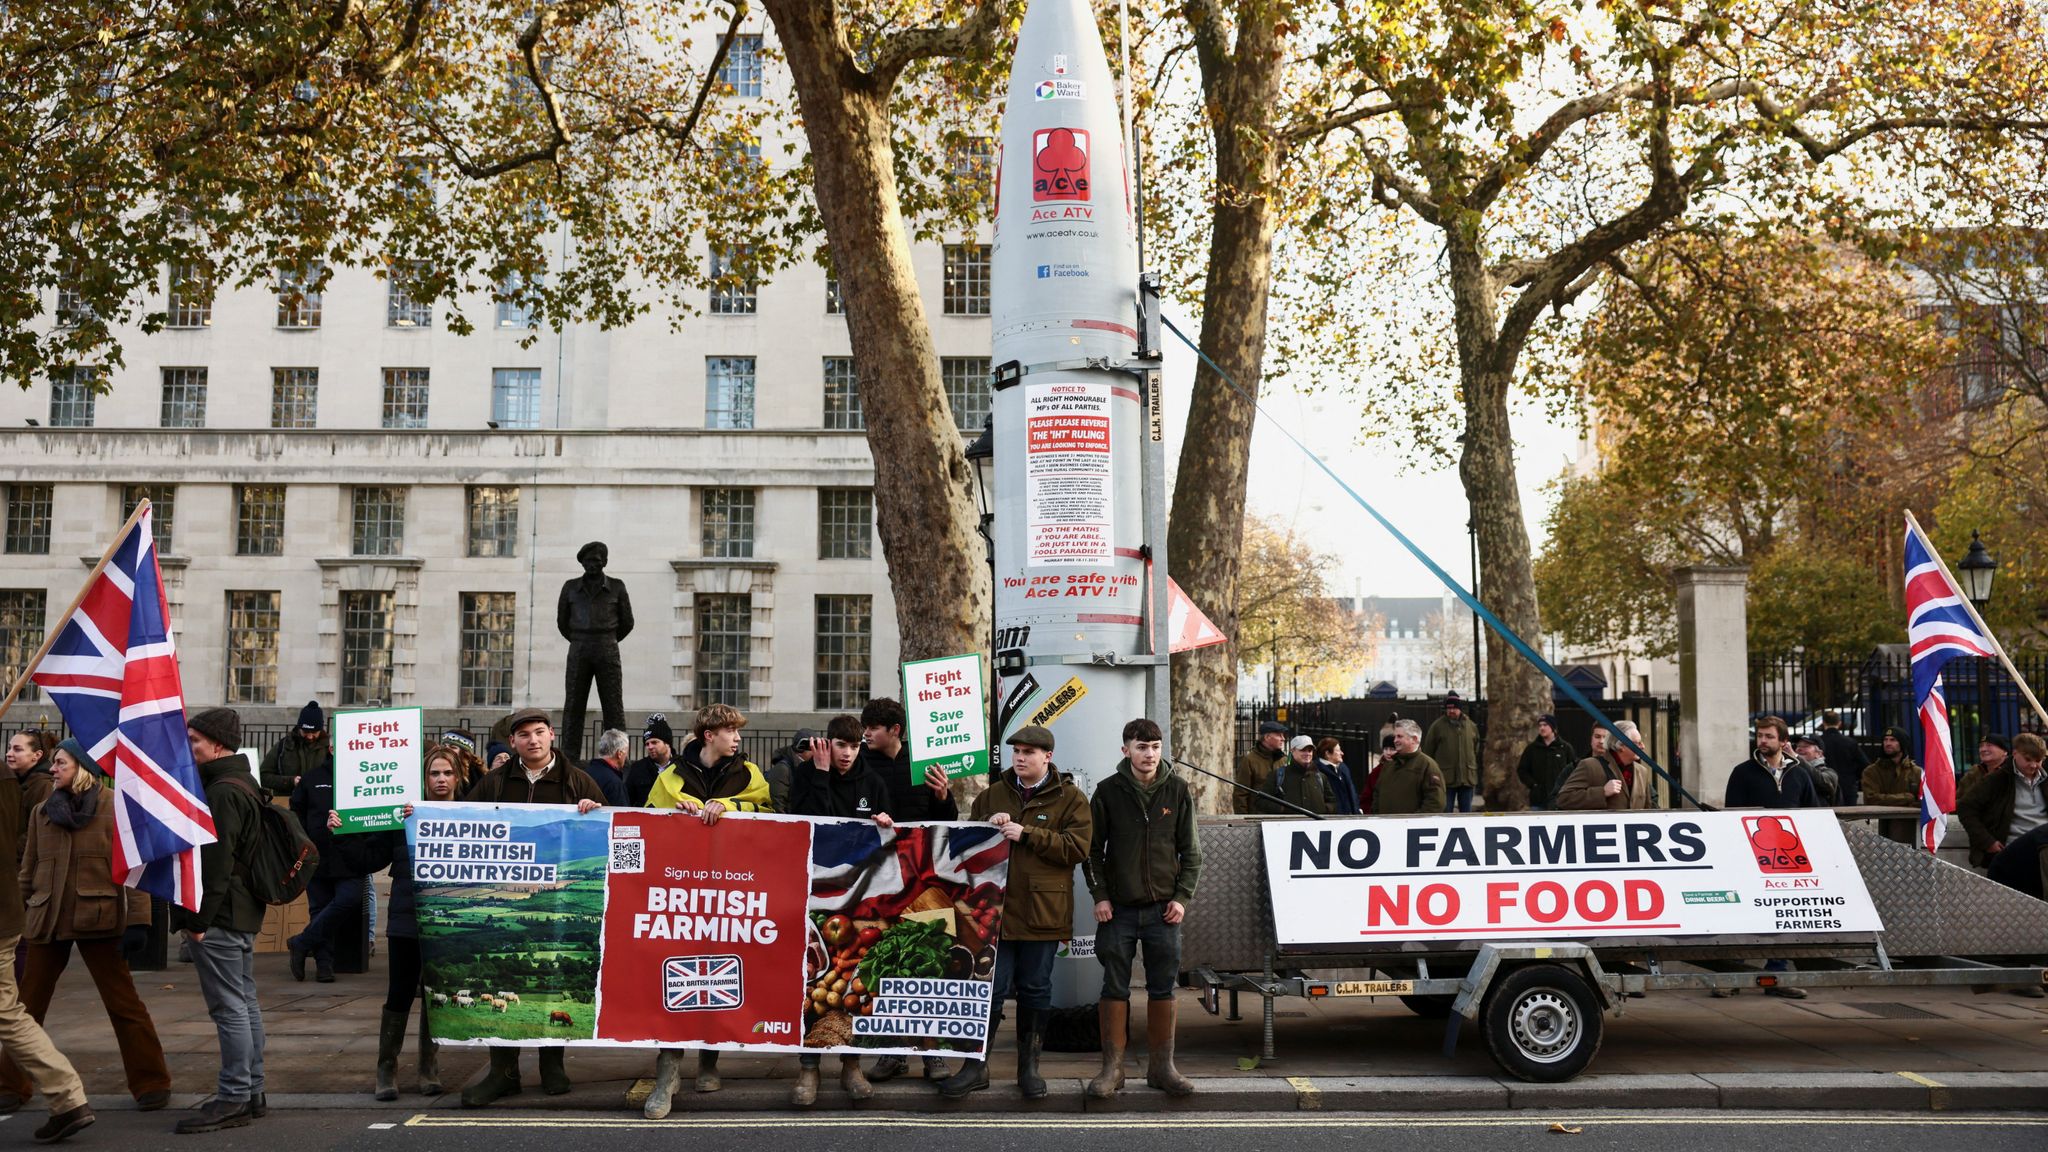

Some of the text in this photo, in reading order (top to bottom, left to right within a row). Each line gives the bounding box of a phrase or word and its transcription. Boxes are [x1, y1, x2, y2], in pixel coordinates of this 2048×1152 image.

[1056, 81, 1080, 89] Baker
[1056, 89, 1080, 97] Ward
[1034, 175, 1089, 193] ace
[1032, 207, 1092, 220] Ace ATV
[1026, 229, 1099, 240] www.aceatv.co.uk
[1054, 269, 1089, 277] Facebook
[1151, 377, 1162, 442] C.L.H. TRAILERS
[1030, 418, 1108, 428] PLEASE PLEASE REVERSE
[1032, 431, 1048, 440] THE
[1071, 429, 1105, 440] RULINGS
[1003, 572, 1138, 588] You are safe with
[1025, 586, 1118, 599] Ace ATV !!
[925, 669, 962, 686] Fight
[918, 685, 971, 702] the Tax
[1009, 679, 1033, 710] Kawasaki
[1031, 685, 1077, 727] TRAILERS
[929, 709, 964, 723] Save
[358, 721, 399, 736] Fight
[936, 723, 960, 734] our
[348, 737, 409, 751] the Tax
[926, 733, 971, 748] Farms
[359, 761, 398, 773] Save
[365, 774, 393, 785] our
[353, 785, 405, 798] Farms
[349, 812, 392, 822] Countryside
[363, 819, 392, 827] Alliance
[419, 821, 508, 839] SHAPING
[418, 842, 533, 861] THE BRITISH
[1289, 823, 1706, 871] NO FARMERS
[1758, 855, 1808, 866] ace
[416, 863, 555, 882] COUNTRYSIDE
[664, 866, 754, 882] Sign up to back
[1764, 878, 1819, 889] Ace ATV
[648, 886, 768, 917] BRITISH
[1367, 879, 1666, 927] NO FOOD
[1754, 896, 1845, 907] SUPPORTING
[1775, 908, 1832, 918] BRITISH
[633, 914, 778, 944] FARMING
[1775, 919, 1842, 930] FARMERS
[1071, 938, 1095, 947] Bake
[686, 979, 710, 987] BRITISH
[710, 978, 738, 986] FARMING
[883, 980, 989, 998] PRODUCING
[1336, 983, 1408, 994] C.L.H. TRAILERS
[875, 1000, 988, 1018] AFFORDABLE
[764, 1021, 792, 1034] NFU
[854, 1019, 986, 1037] QUALITY FOOD
